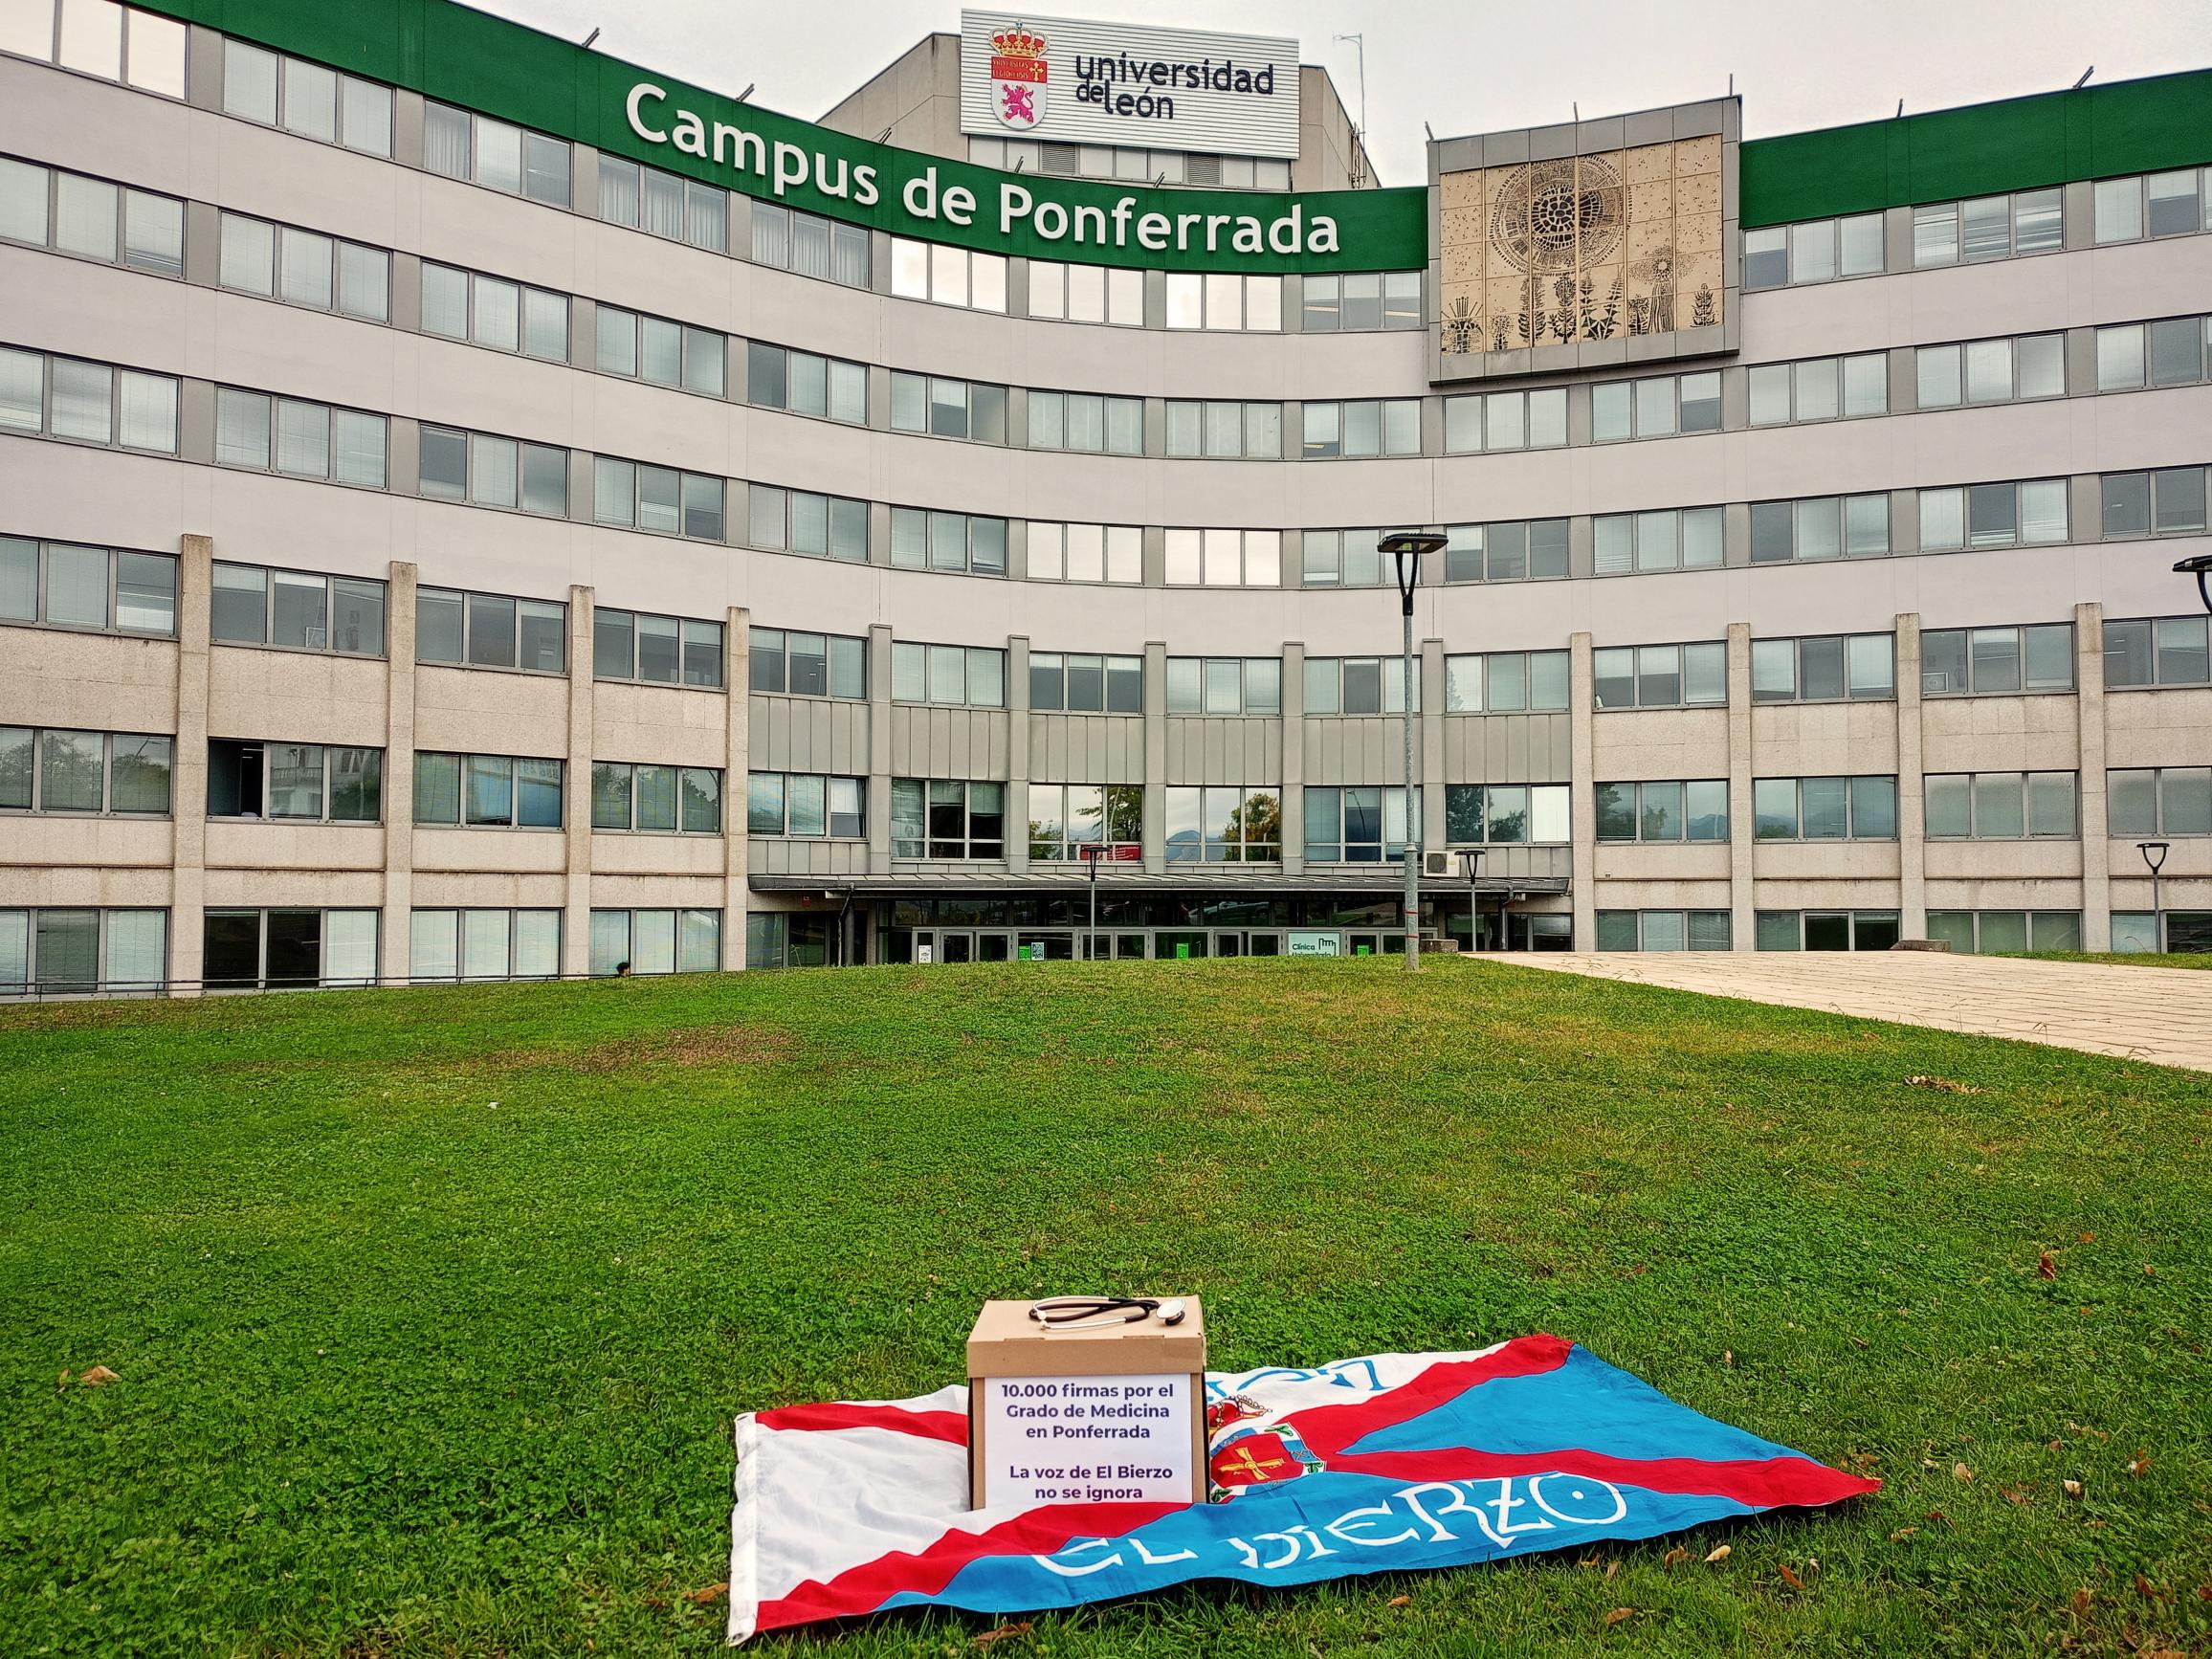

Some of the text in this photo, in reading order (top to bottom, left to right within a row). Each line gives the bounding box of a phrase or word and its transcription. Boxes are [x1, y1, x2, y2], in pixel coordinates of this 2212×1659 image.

[1075, 52, 1273, 96] universidad
[1075, 78, 1174, 120] de león
[625, 81, 1339, 255] Campus de Ponferrada
[1002, 1383, 1174, 1400] 10.000 firmas por el
[1006, 1404, 1170, 1418] Grado de Medicina
[1026, 1425, 1150, 1439] en Ponferrada
[1009, 1465, 1173, 1479] La voz de El Bierzo
[1035, 1485, 1143, 1502] no se ignora
